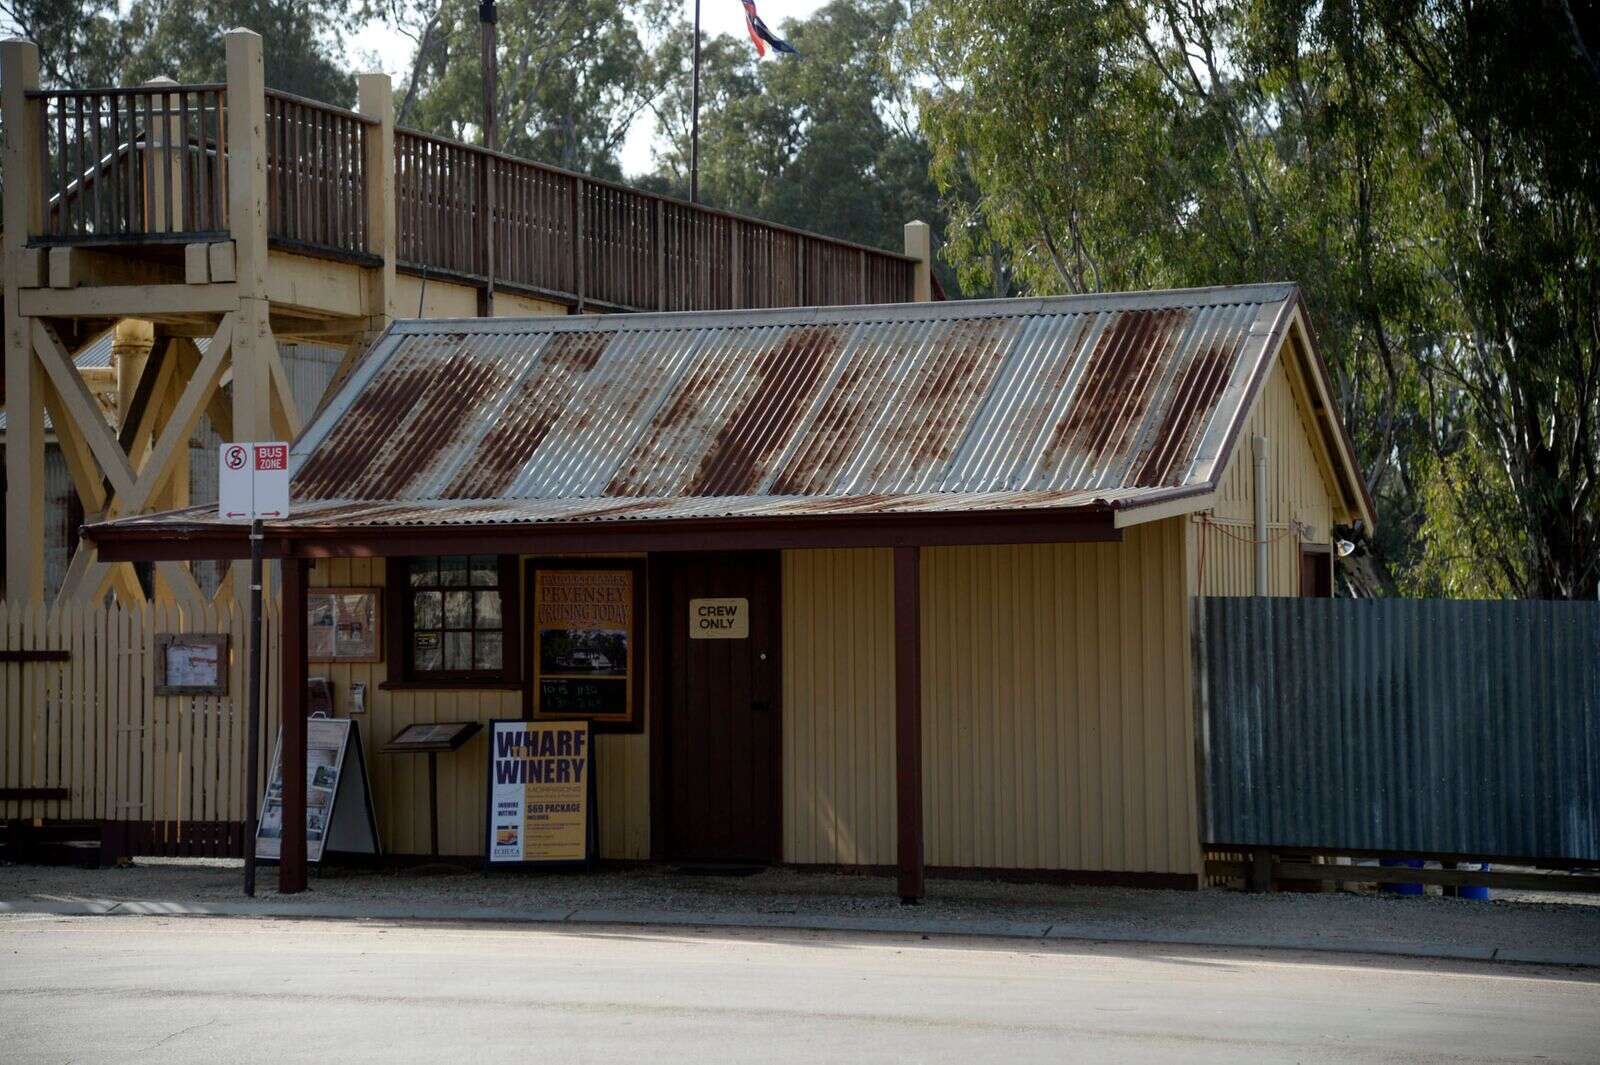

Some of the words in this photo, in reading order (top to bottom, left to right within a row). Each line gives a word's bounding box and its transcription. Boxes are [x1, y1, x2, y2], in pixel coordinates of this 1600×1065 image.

[259, 447, 283, 458] BUS
[259, 459, 282, 469] ZONE
[543, 587, 625, 603] PEVENSEY
[698, 605, 738, 617] CREW
[699, 618, 735, 629] ONLY
[496, 730, 585, 757] WHARF
[496, 758, 585, 784] WINERY
[545, 803, 580, 813] PACKAGE
